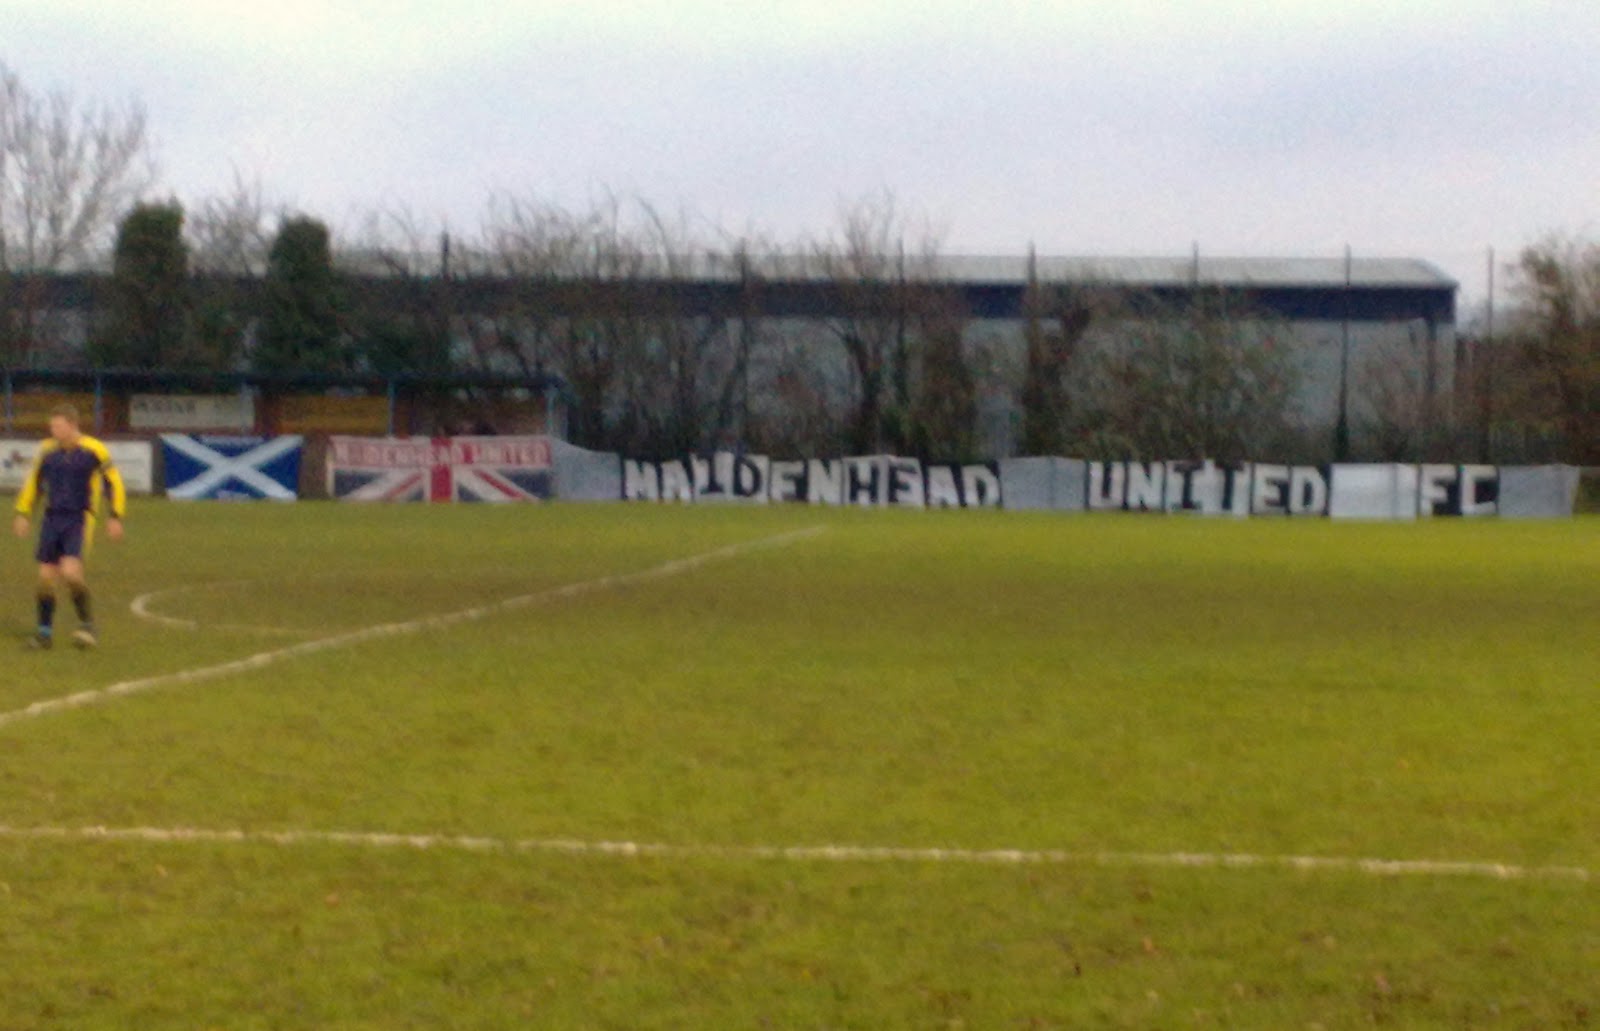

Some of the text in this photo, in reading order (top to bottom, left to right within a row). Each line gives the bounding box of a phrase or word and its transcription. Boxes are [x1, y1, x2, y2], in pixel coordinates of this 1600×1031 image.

[624, 454, 1498, 516] MAIDENHEAD UNITED FC
